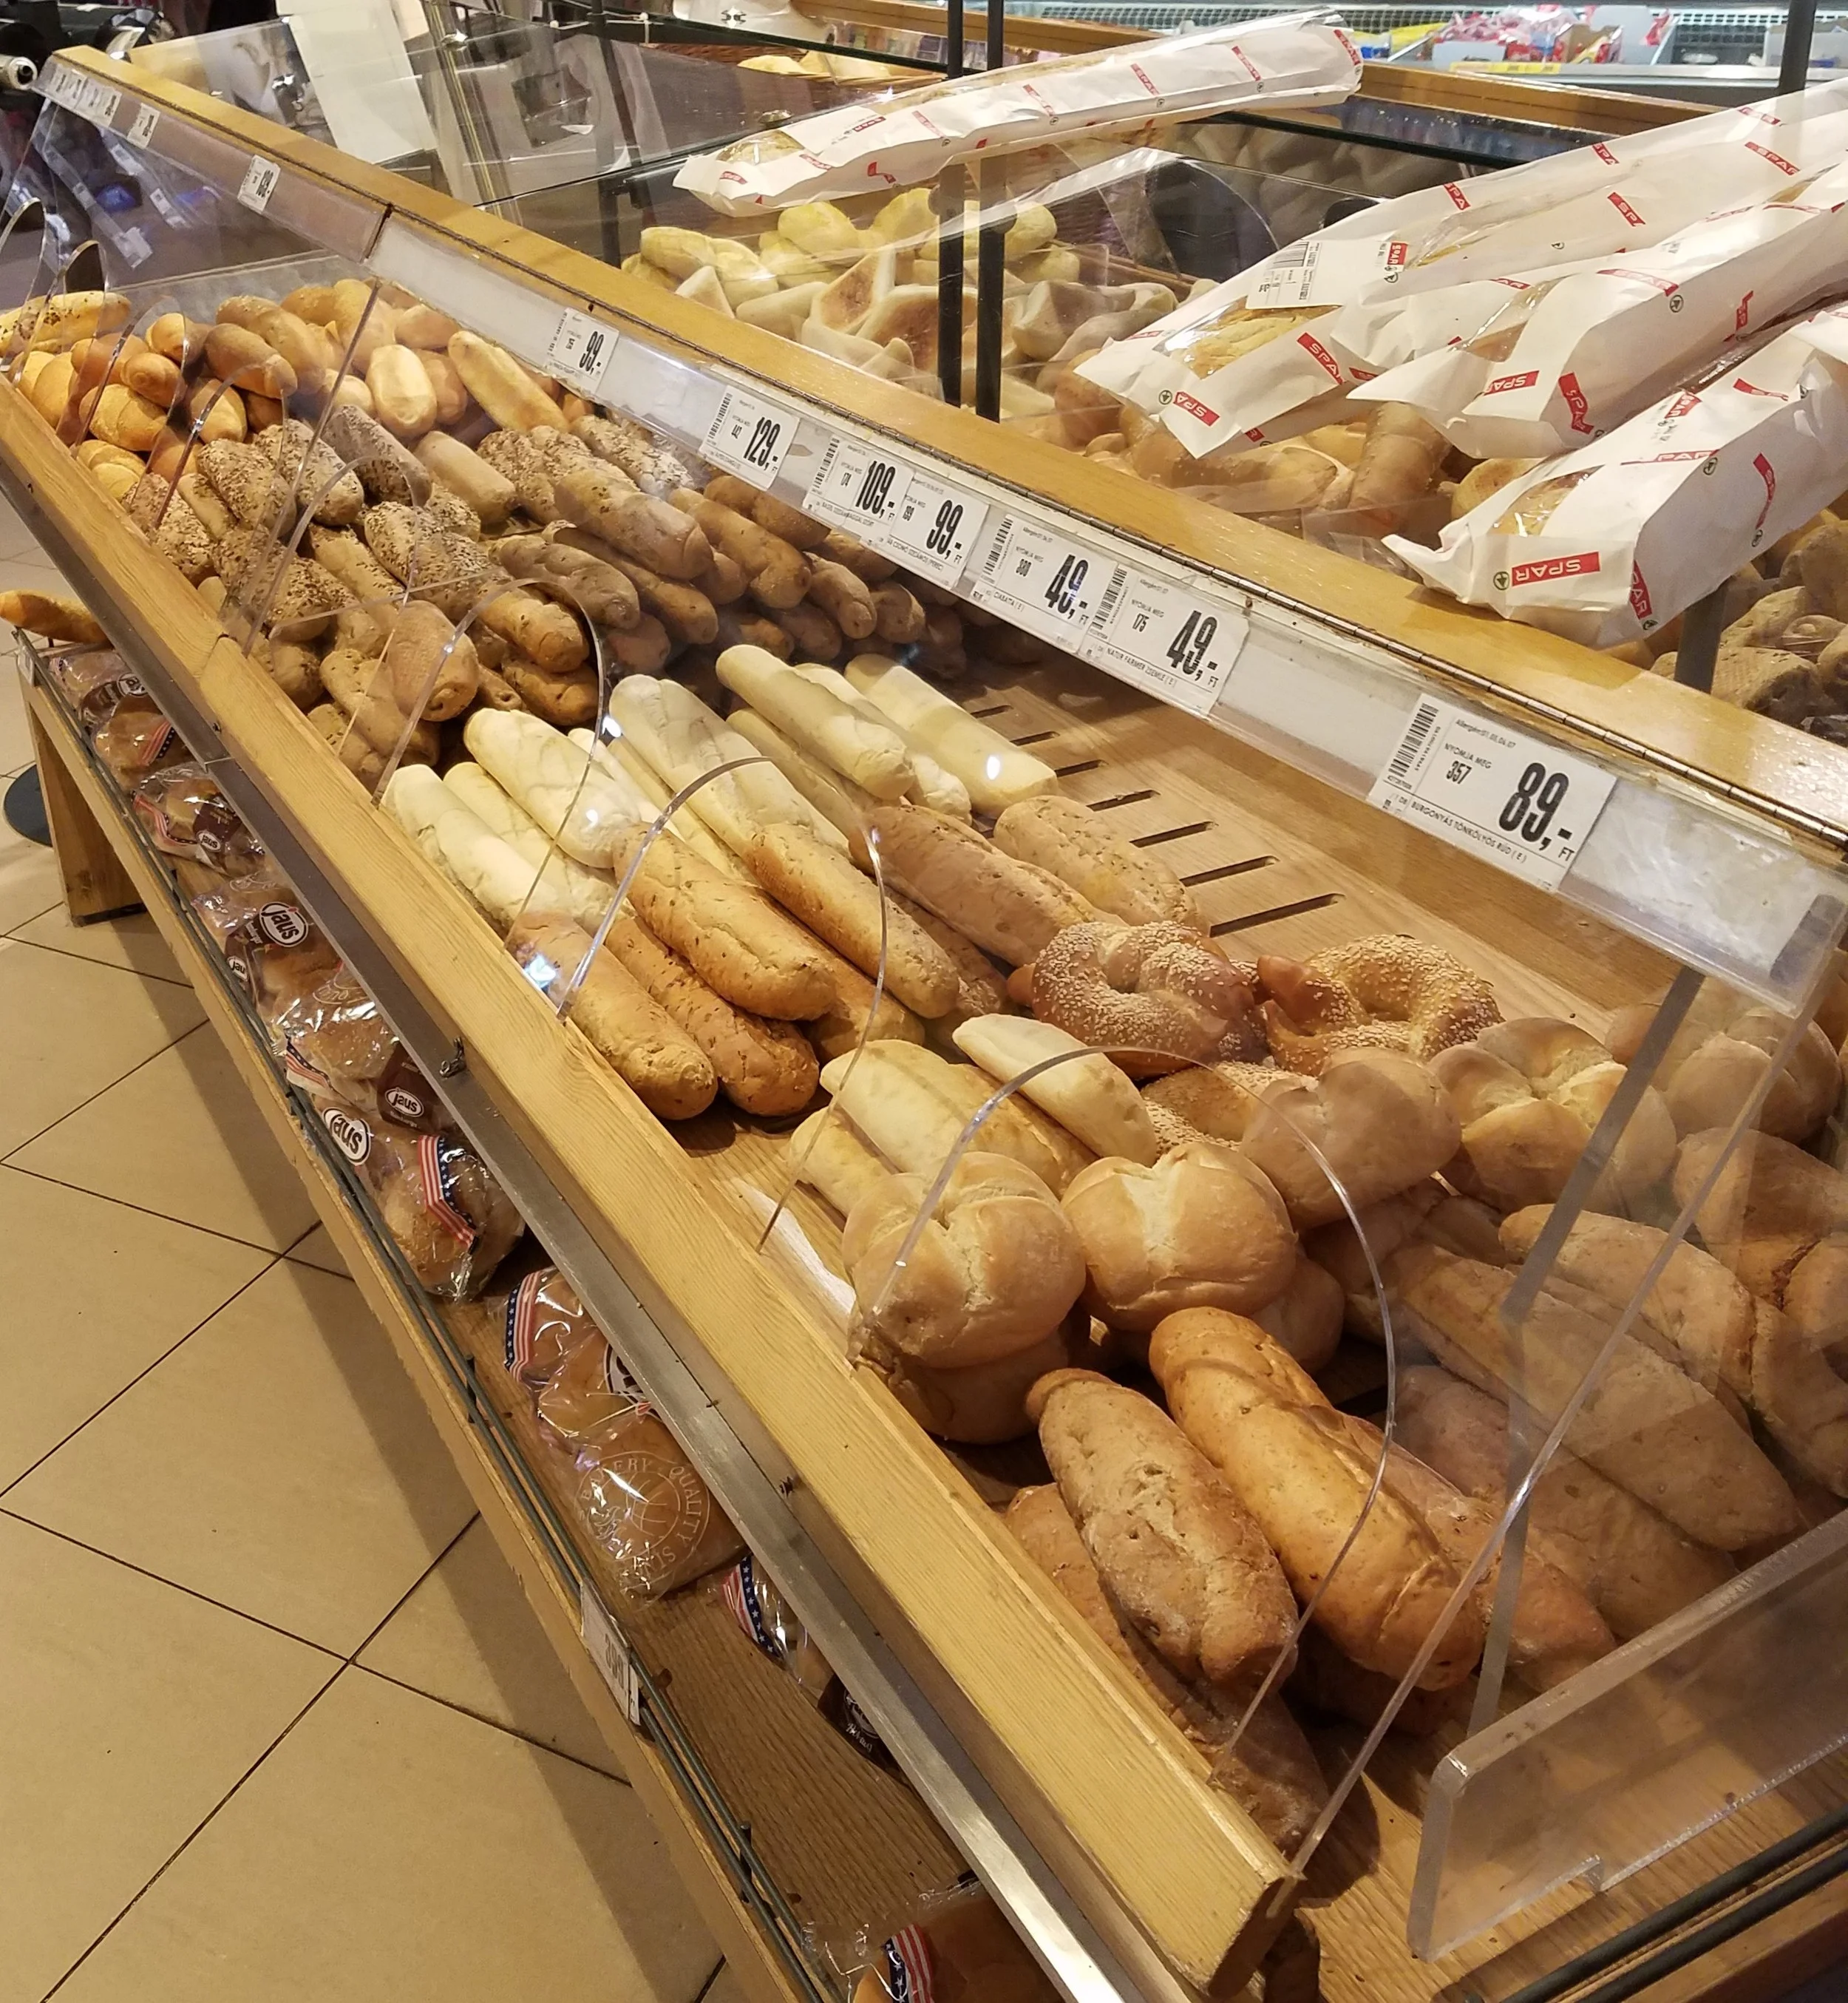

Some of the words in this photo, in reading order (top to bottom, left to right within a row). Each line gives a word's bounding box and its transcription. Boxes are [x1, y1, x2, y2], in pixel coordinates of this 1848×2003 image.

[1390, 242, 1403, 265] SPAR
[579, 331, 605, 375] 99,-
[1308, 342, 1345, 384] SPA
[1485, 375, 1528, 393] SPA
[743, 416, 781, 470] 129,-
[855, 460, 896, 518] 109,-
[926, 499, 963, 560] 99,-
[1515, 558, 1582, 583] SPAR
[1044, 554, 1089, 620] 49,-
[1132, 613, 1149, 633] 175
[1166, 610, 1218, 680] 49,-
[1207, 675, 1218, 688] FT
[1443, 742, 1475, 762] NYOMJA
[1474, 756, 1492, 769] MEG
[1446, 761, 1472, 785] 357
[1498, 762, 1572, 852] 89,-
[200, 834, 219, 850] jaus
[1557, 845, 1575, 863] FT
[261, 908, 300, 941] jaus
[391, 1092, 418, 1113] jaus
[668, 1465, 703, 1544] QUALITY
